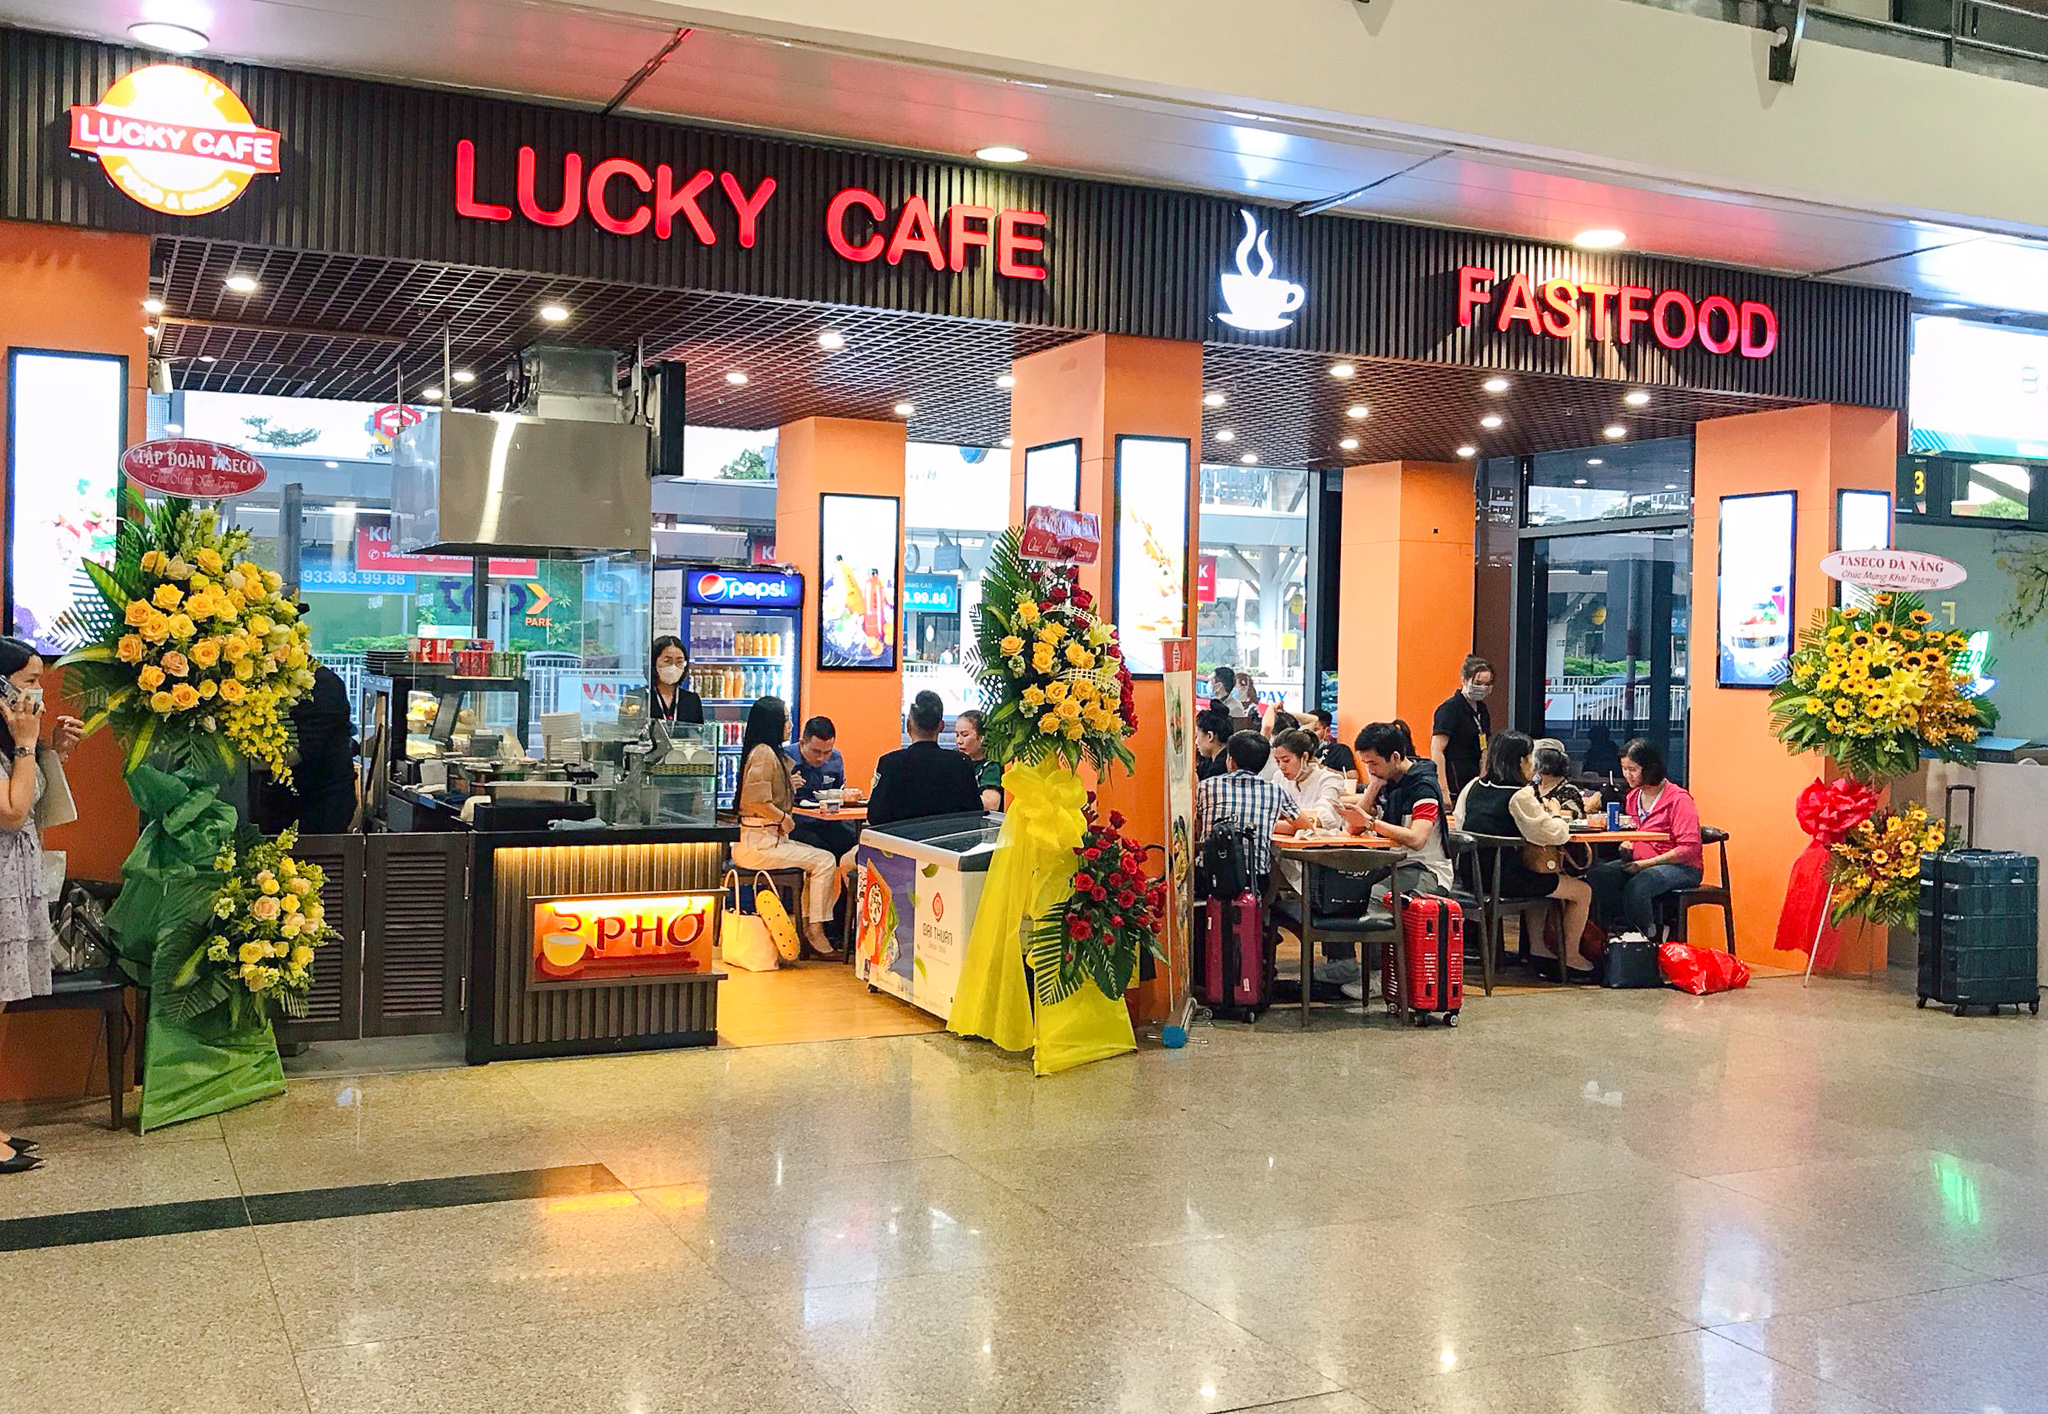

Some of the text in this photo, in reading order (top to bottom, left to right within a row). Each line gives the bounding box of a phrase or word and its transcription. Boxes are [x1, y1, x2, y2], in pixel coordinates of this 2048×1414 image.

[80, 113, 273, 165] LUCKY CAFE
[456, 139, 1047, 281] LUCKY CAFE
[1457, 265, 1778, 360] FASTFOOD
[1914, 470, 1925, 495] 3
[1839, 555, 1944, 573] TASECO ĐÀ NẴNG
[729, 580, 786, 601] pepsi
[524, 617, 553, 627] PARK
